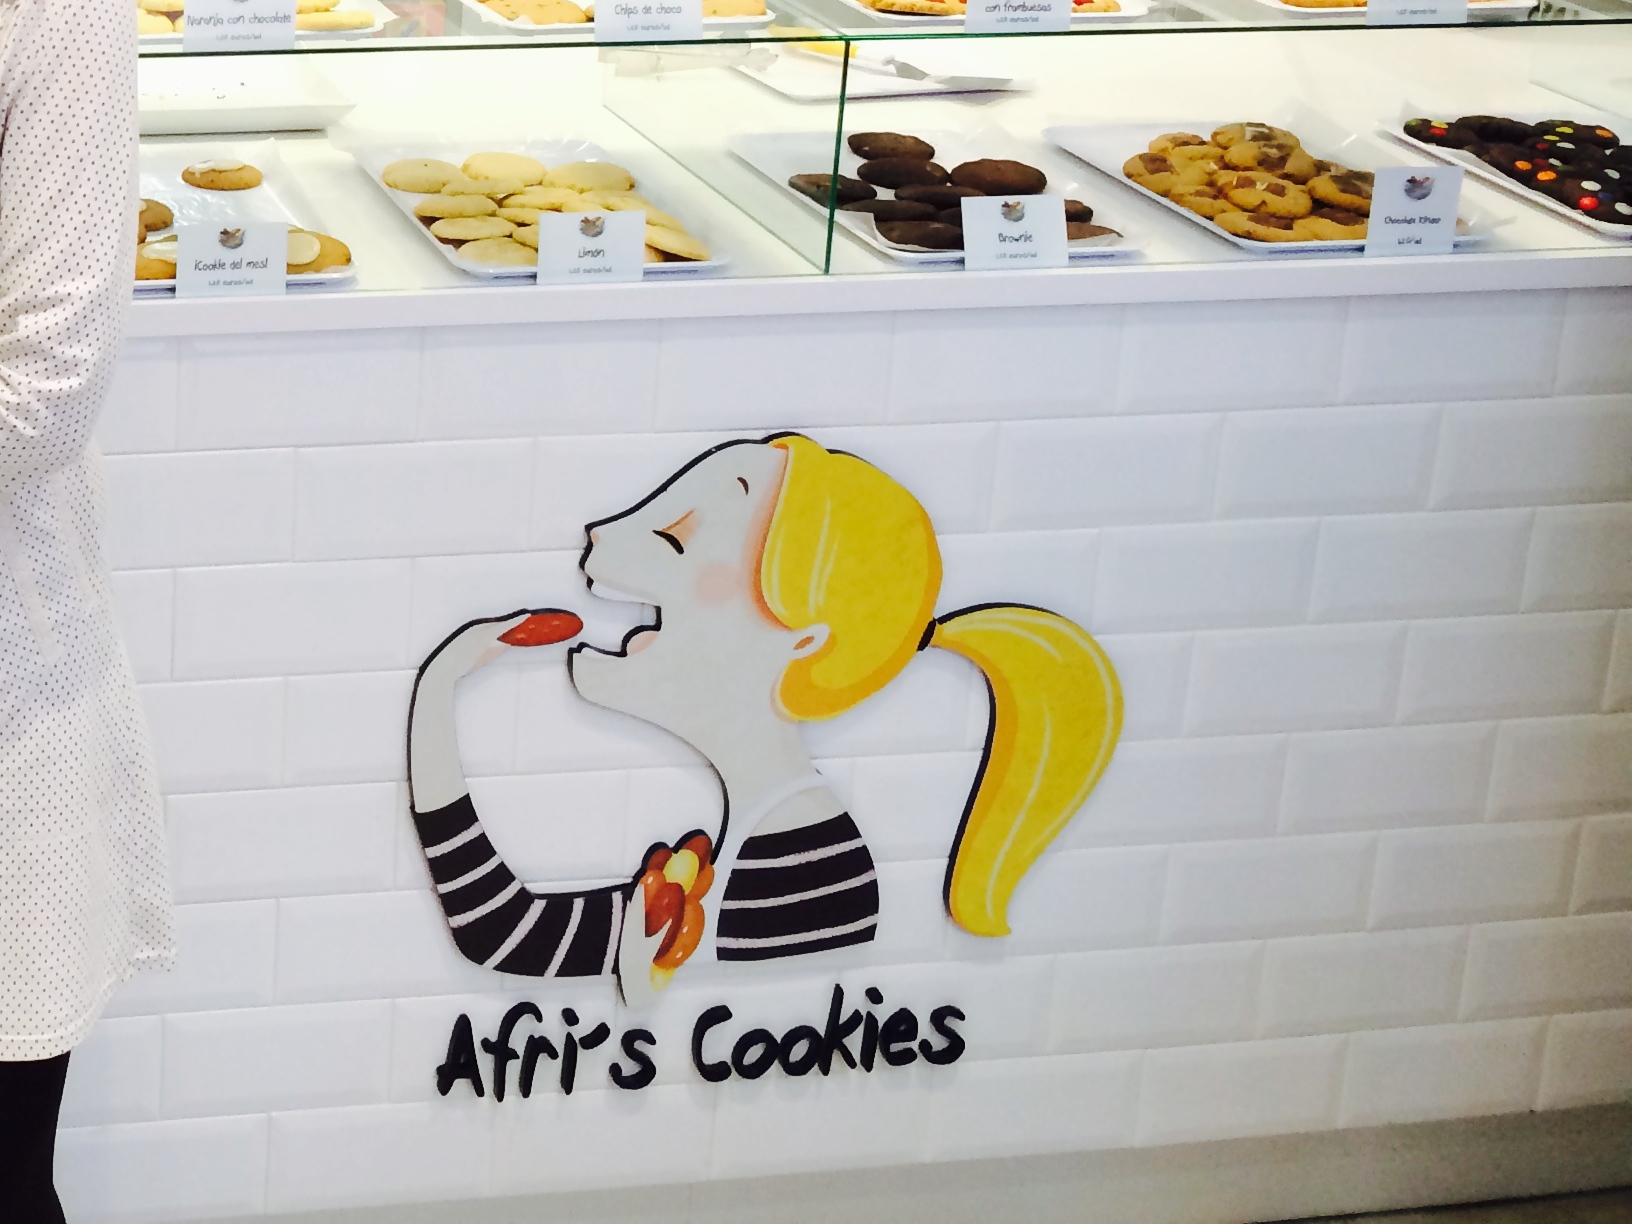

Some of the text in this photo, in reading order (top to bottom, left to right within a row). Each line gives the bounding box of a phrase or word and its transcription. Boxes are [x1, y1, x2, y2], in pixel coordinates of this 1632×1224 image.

[614, 2, 682, 18] Chips de choco
[985, 1, 1052, 12] con frambuesas
[186, 11, 292, 27] Naranja con chocolate
[997, 230, 1033, 243] Brownie
[578, 247, 605, 258] Limón
[229, 257, 243, 270] del
[436, 983, 966, 1103] Afri's Cookies
